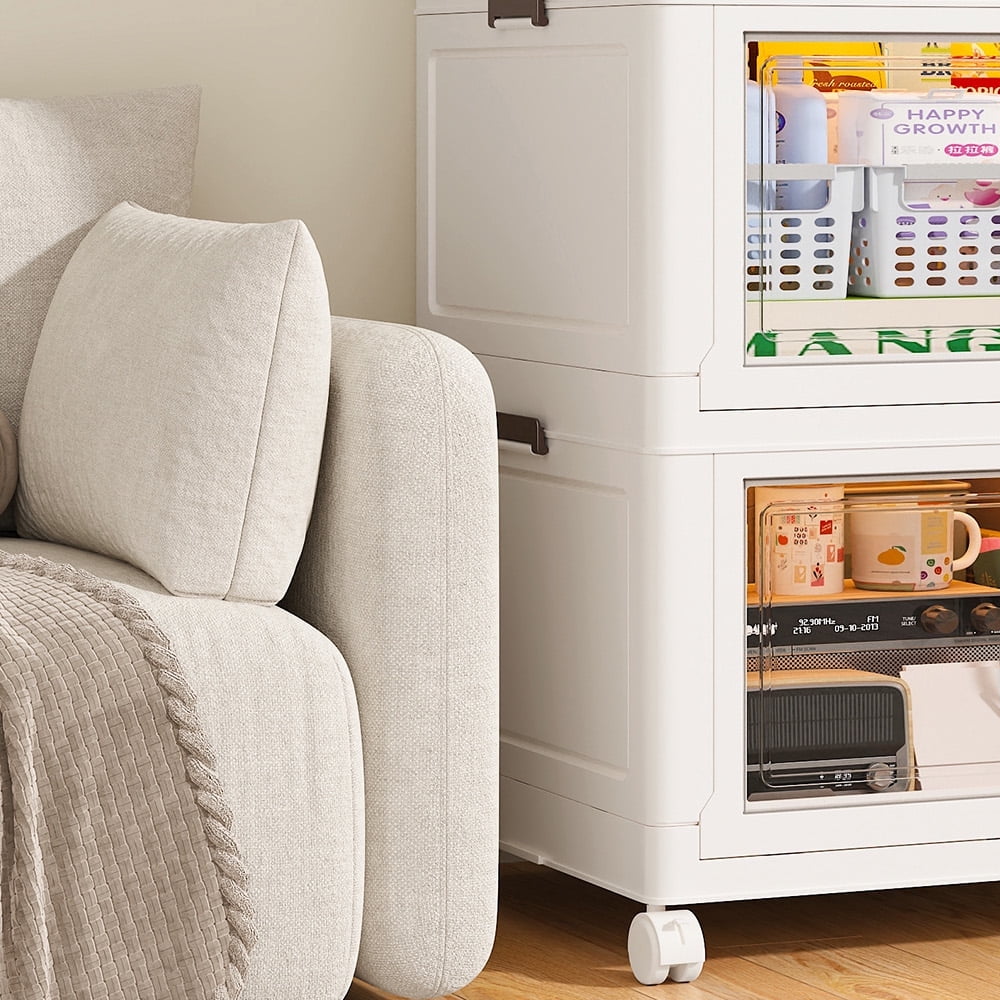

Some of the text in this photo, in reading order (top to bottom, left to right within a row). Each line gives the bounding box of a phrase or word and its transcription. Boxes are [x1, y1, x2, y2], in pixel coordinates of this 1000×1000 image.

[907, 109, 985, 121] HAPPY
[893, 123, 997, 135] GROWTH
[798, 615, 879, 626] 92.90MHz FM
[834, 622, 879, 633] 09-10-2013
